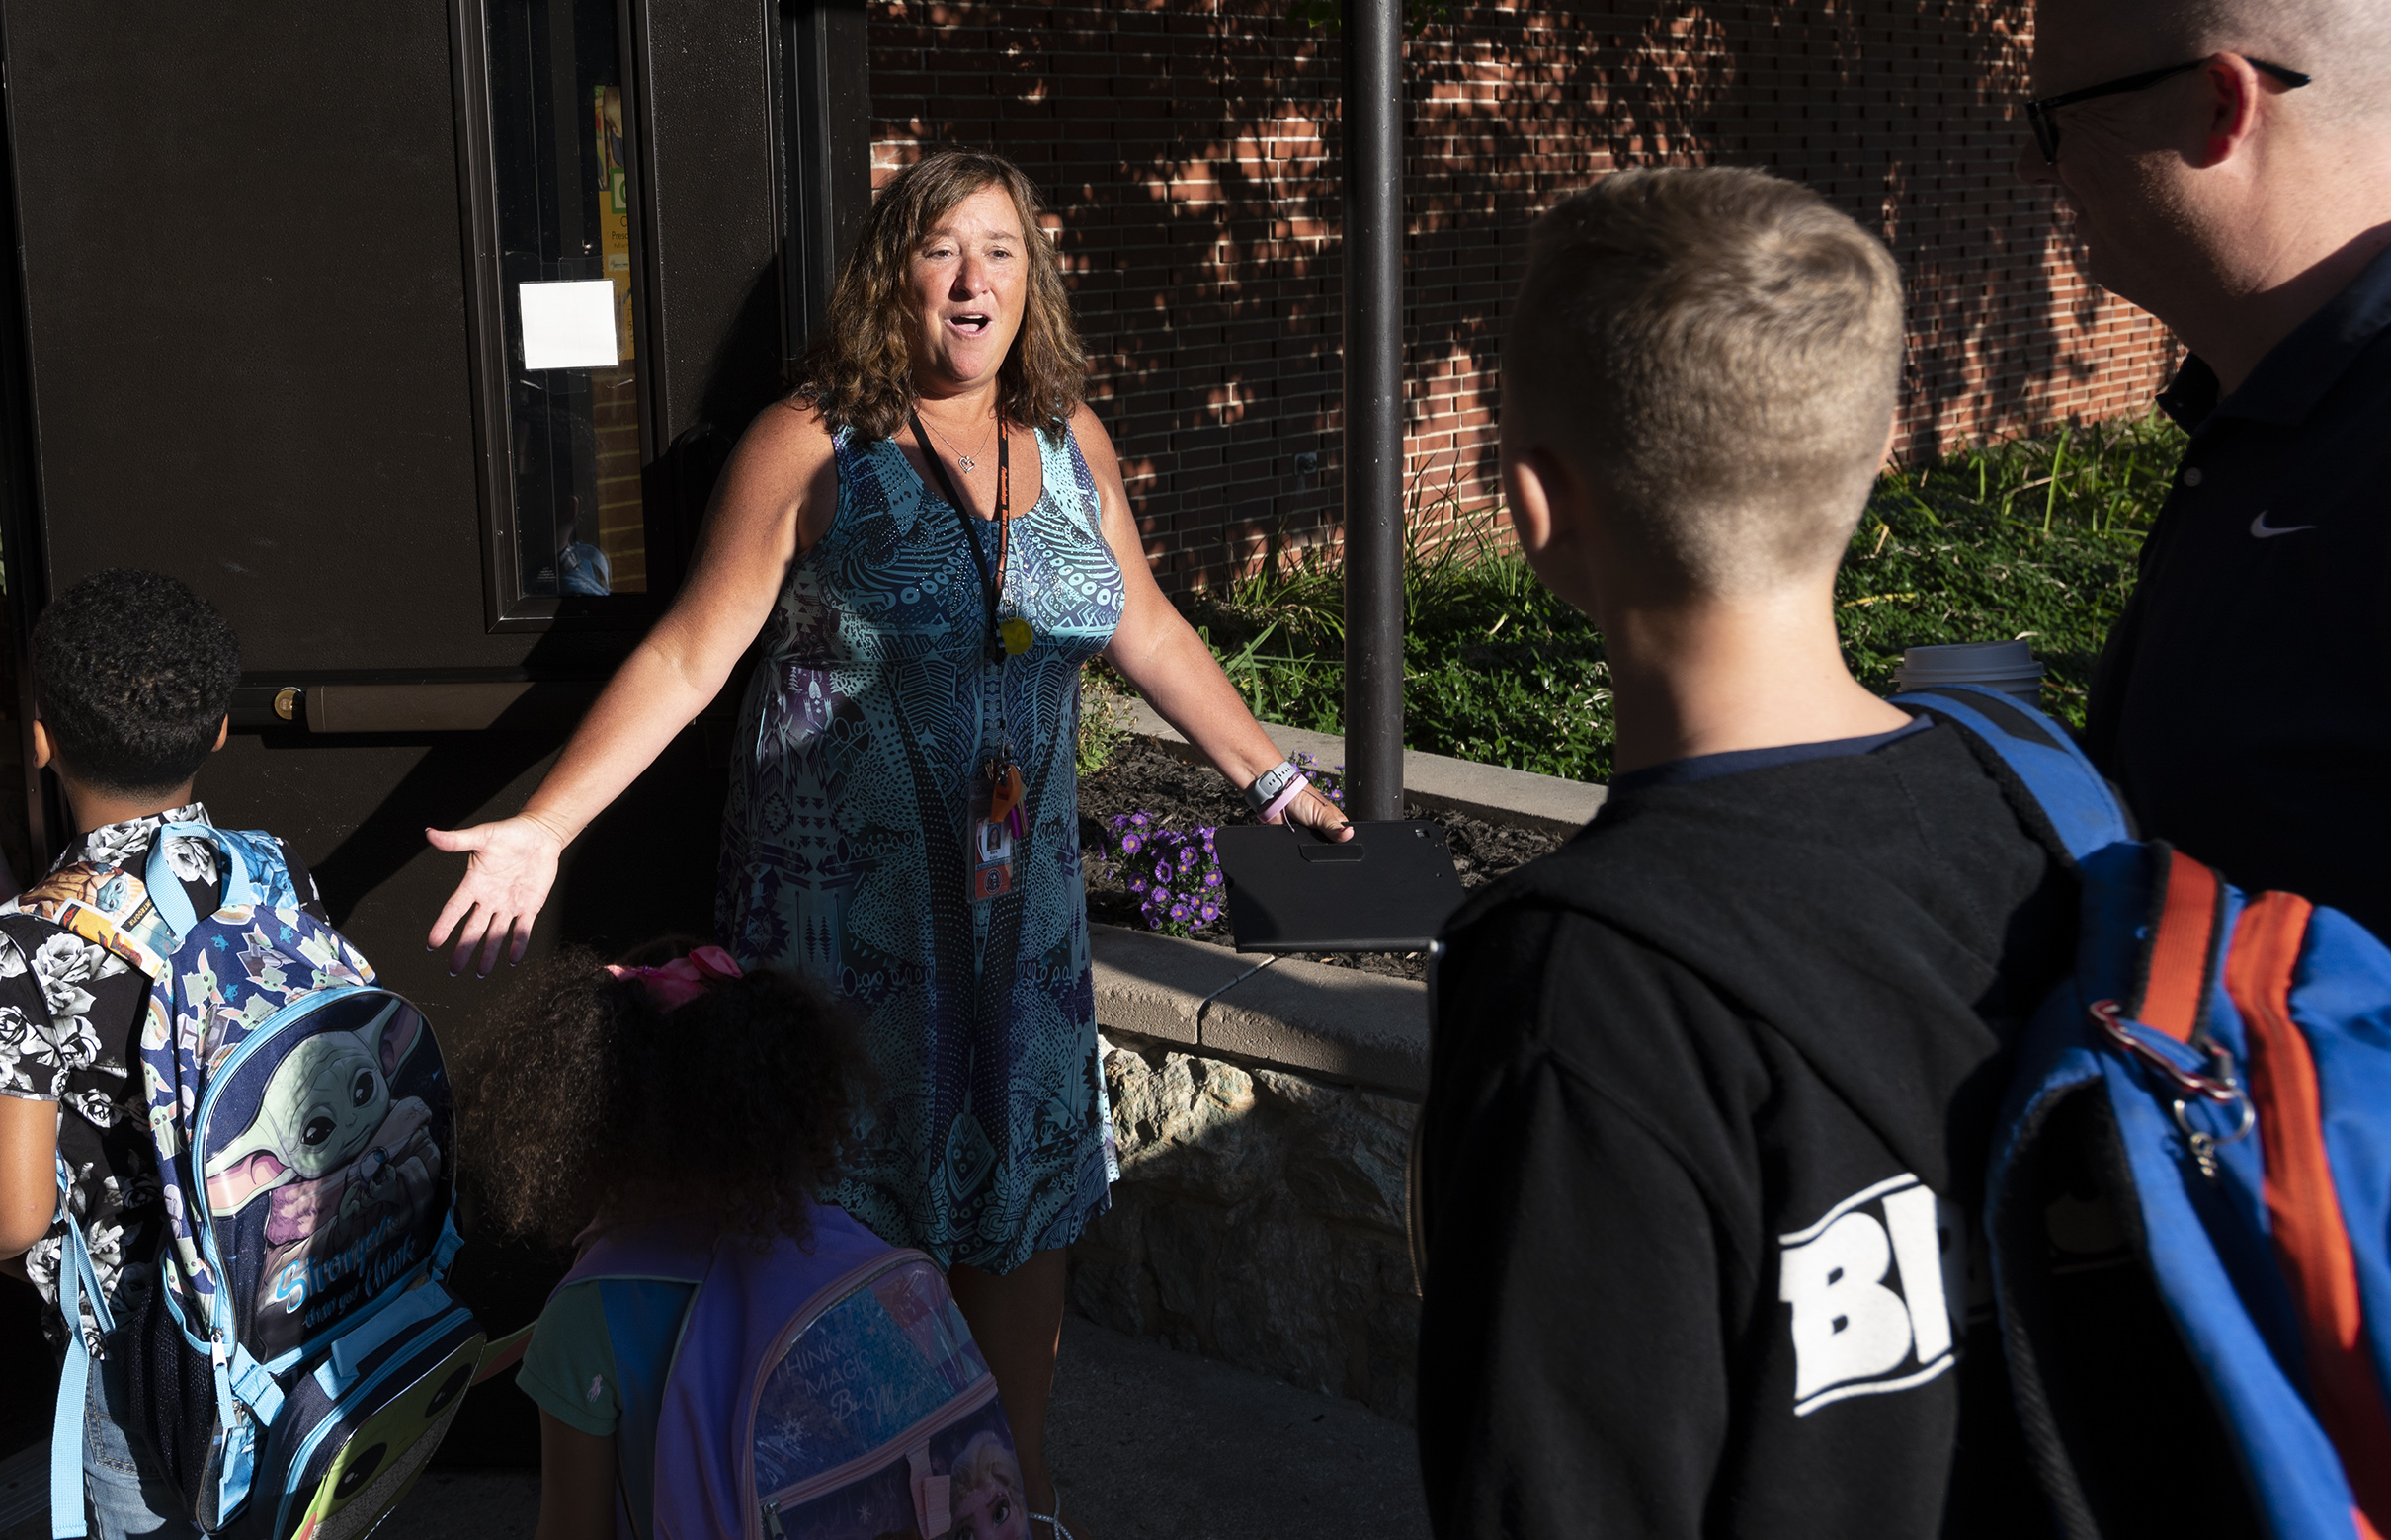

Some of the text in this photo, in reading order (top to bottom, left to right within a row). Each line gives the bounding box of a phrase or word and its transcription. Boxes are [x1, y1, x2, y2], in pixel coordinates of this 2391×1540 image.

[276, 1214, 393, 1315] Stronger
[302, 1296, 337, 1329] than
[364, 1232, 416, 1298] think
[804, 1349, 873, 1398] MAGIC
[830, 1388, 863, 1420] Be
